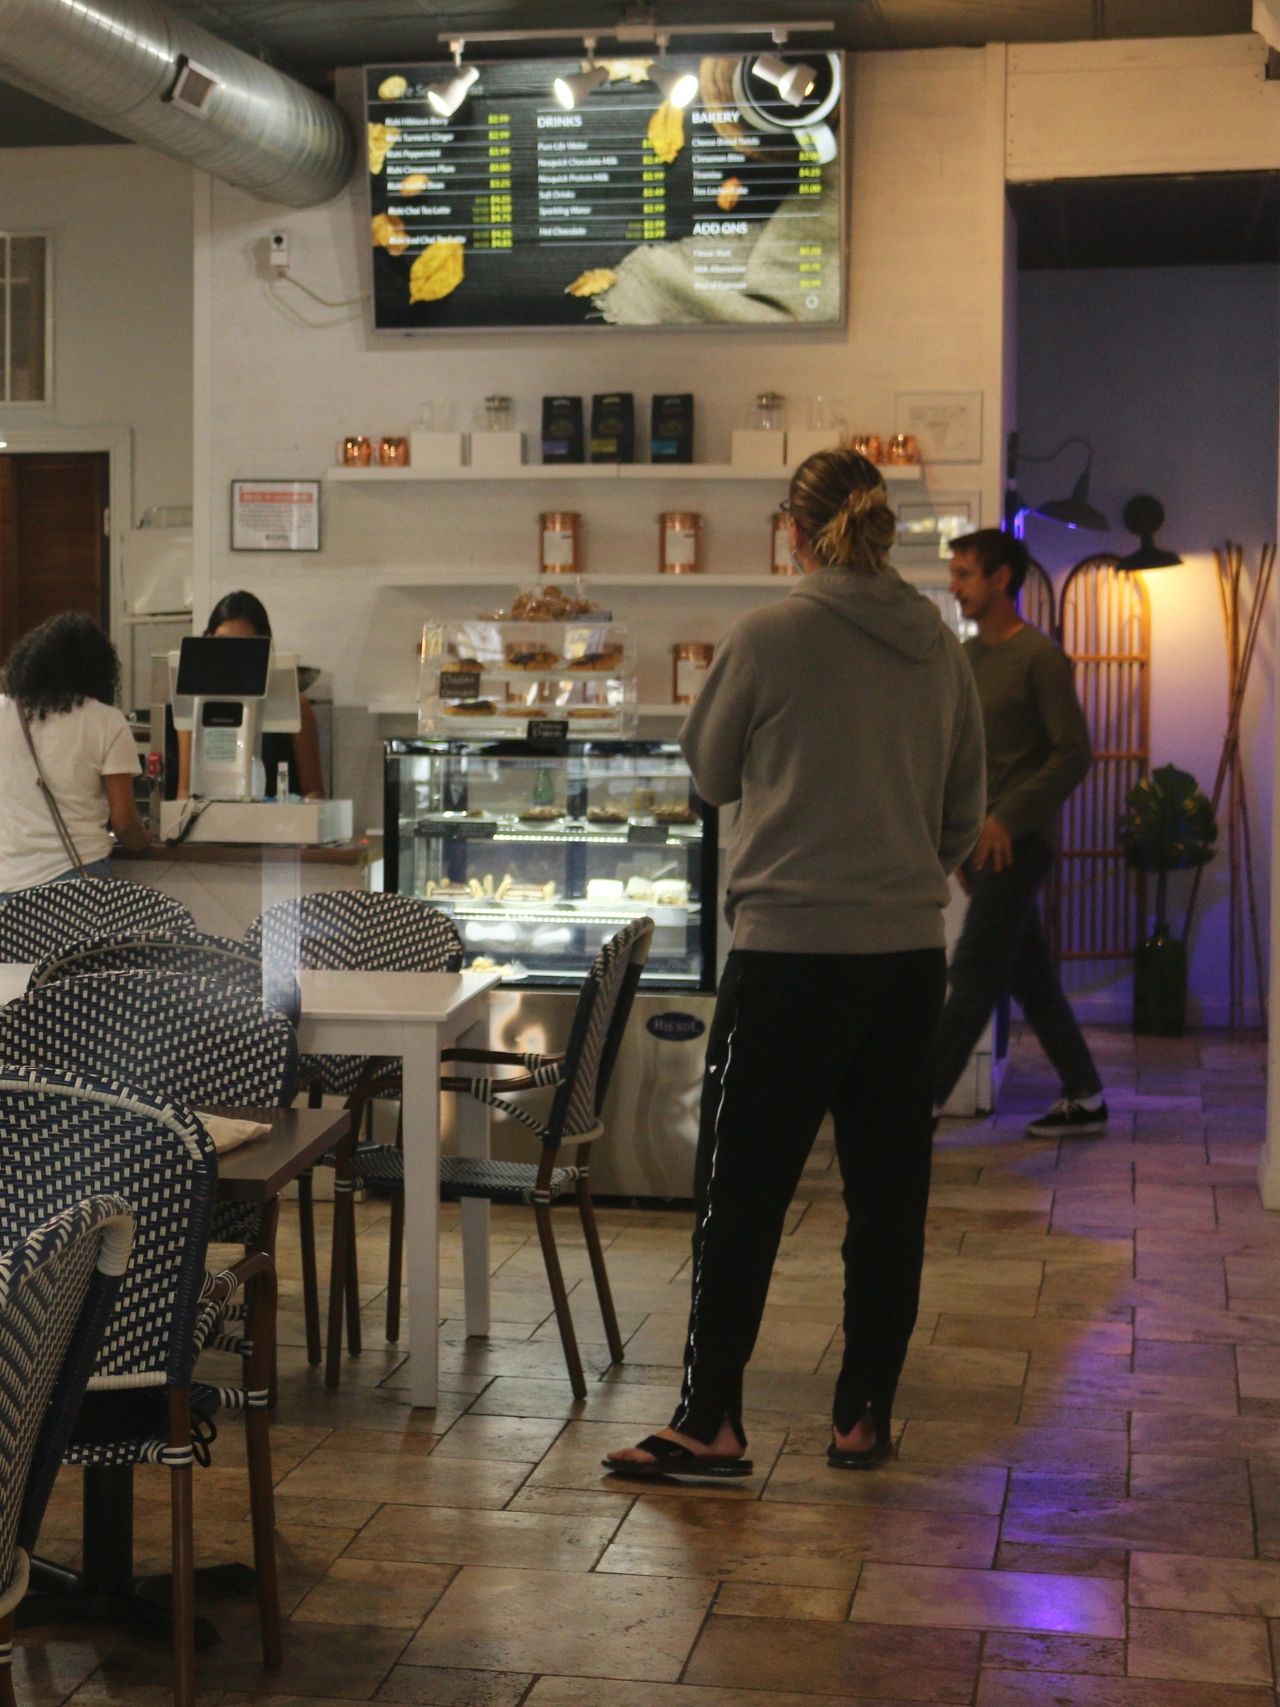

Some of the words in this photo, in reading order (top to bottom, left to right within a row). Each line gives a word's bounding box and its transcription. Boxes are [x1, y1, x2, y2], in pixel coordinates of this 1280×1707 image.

[537, 115, 583, 128] DRINKS
[692, 111, 740, 124] BAKERY
[693, 222, 721, 235] ADD
[722, 222, 748, 234] ONS
